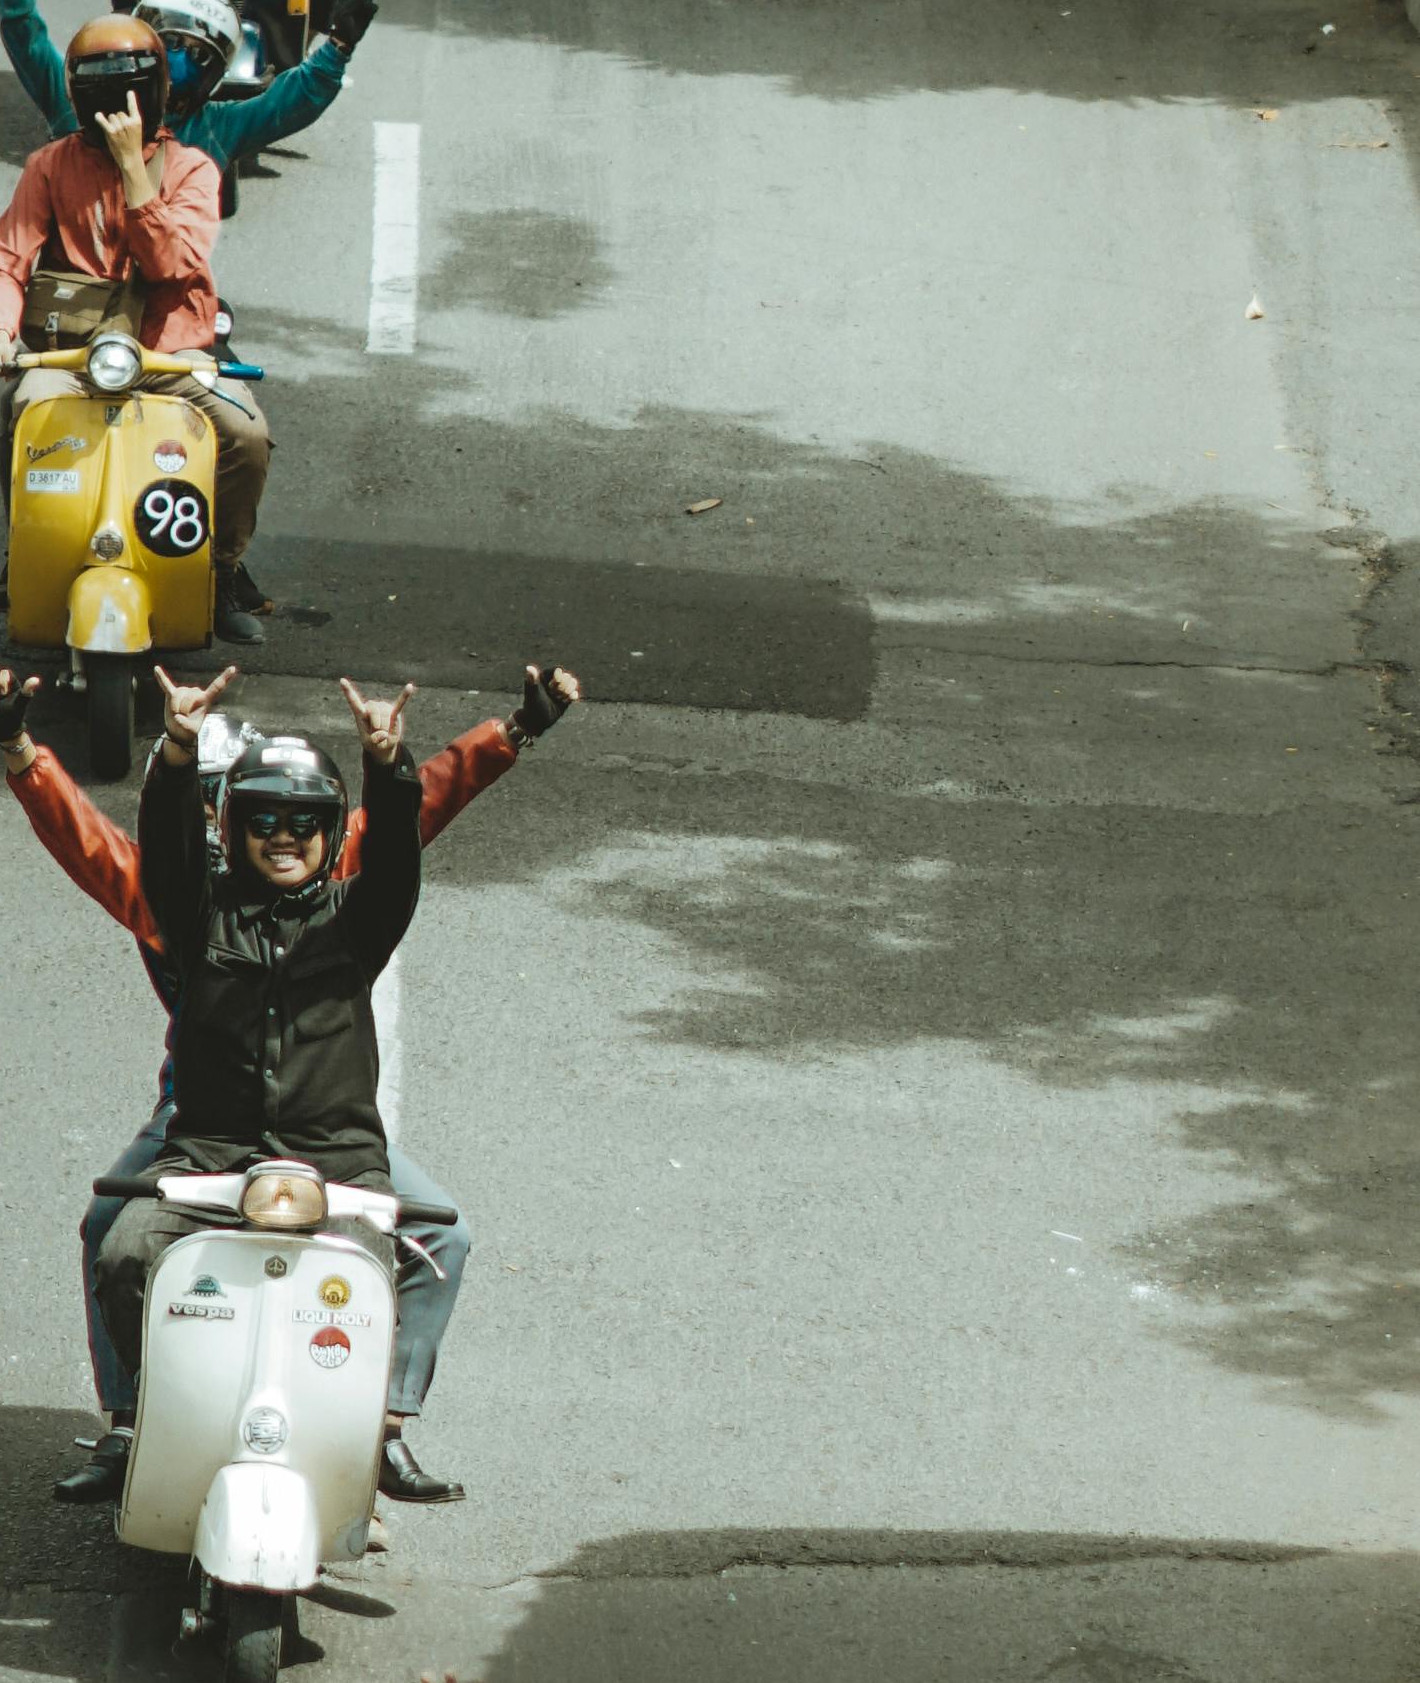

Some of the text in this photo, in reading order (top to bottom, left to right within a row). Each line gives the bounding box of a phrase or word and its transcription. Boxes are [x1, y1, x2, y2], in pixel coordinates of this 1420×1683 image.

[144, 489, 203, 548] 98
[169, 1303, 235, 1321] vespa
[292, 1309, 371, 1327] LIQUI MOLY
